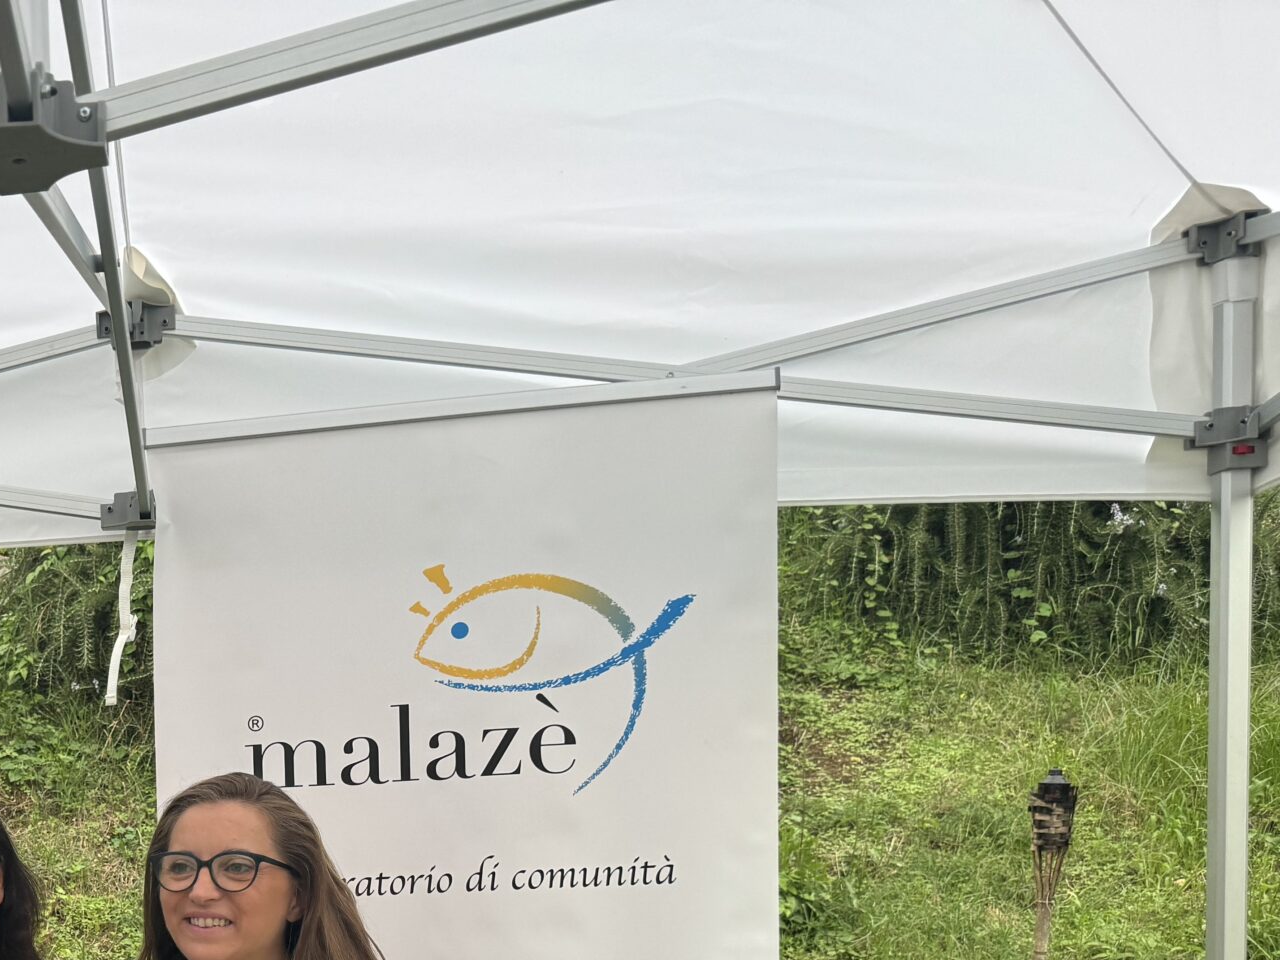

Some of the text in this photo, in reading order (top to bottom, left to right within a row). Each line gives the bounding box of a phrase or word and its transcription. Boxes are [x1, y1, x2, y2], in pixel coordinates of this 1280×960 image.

[244, 693, 577, 788] malazè
[342, 854, 678, 897] ratorio di comunità
